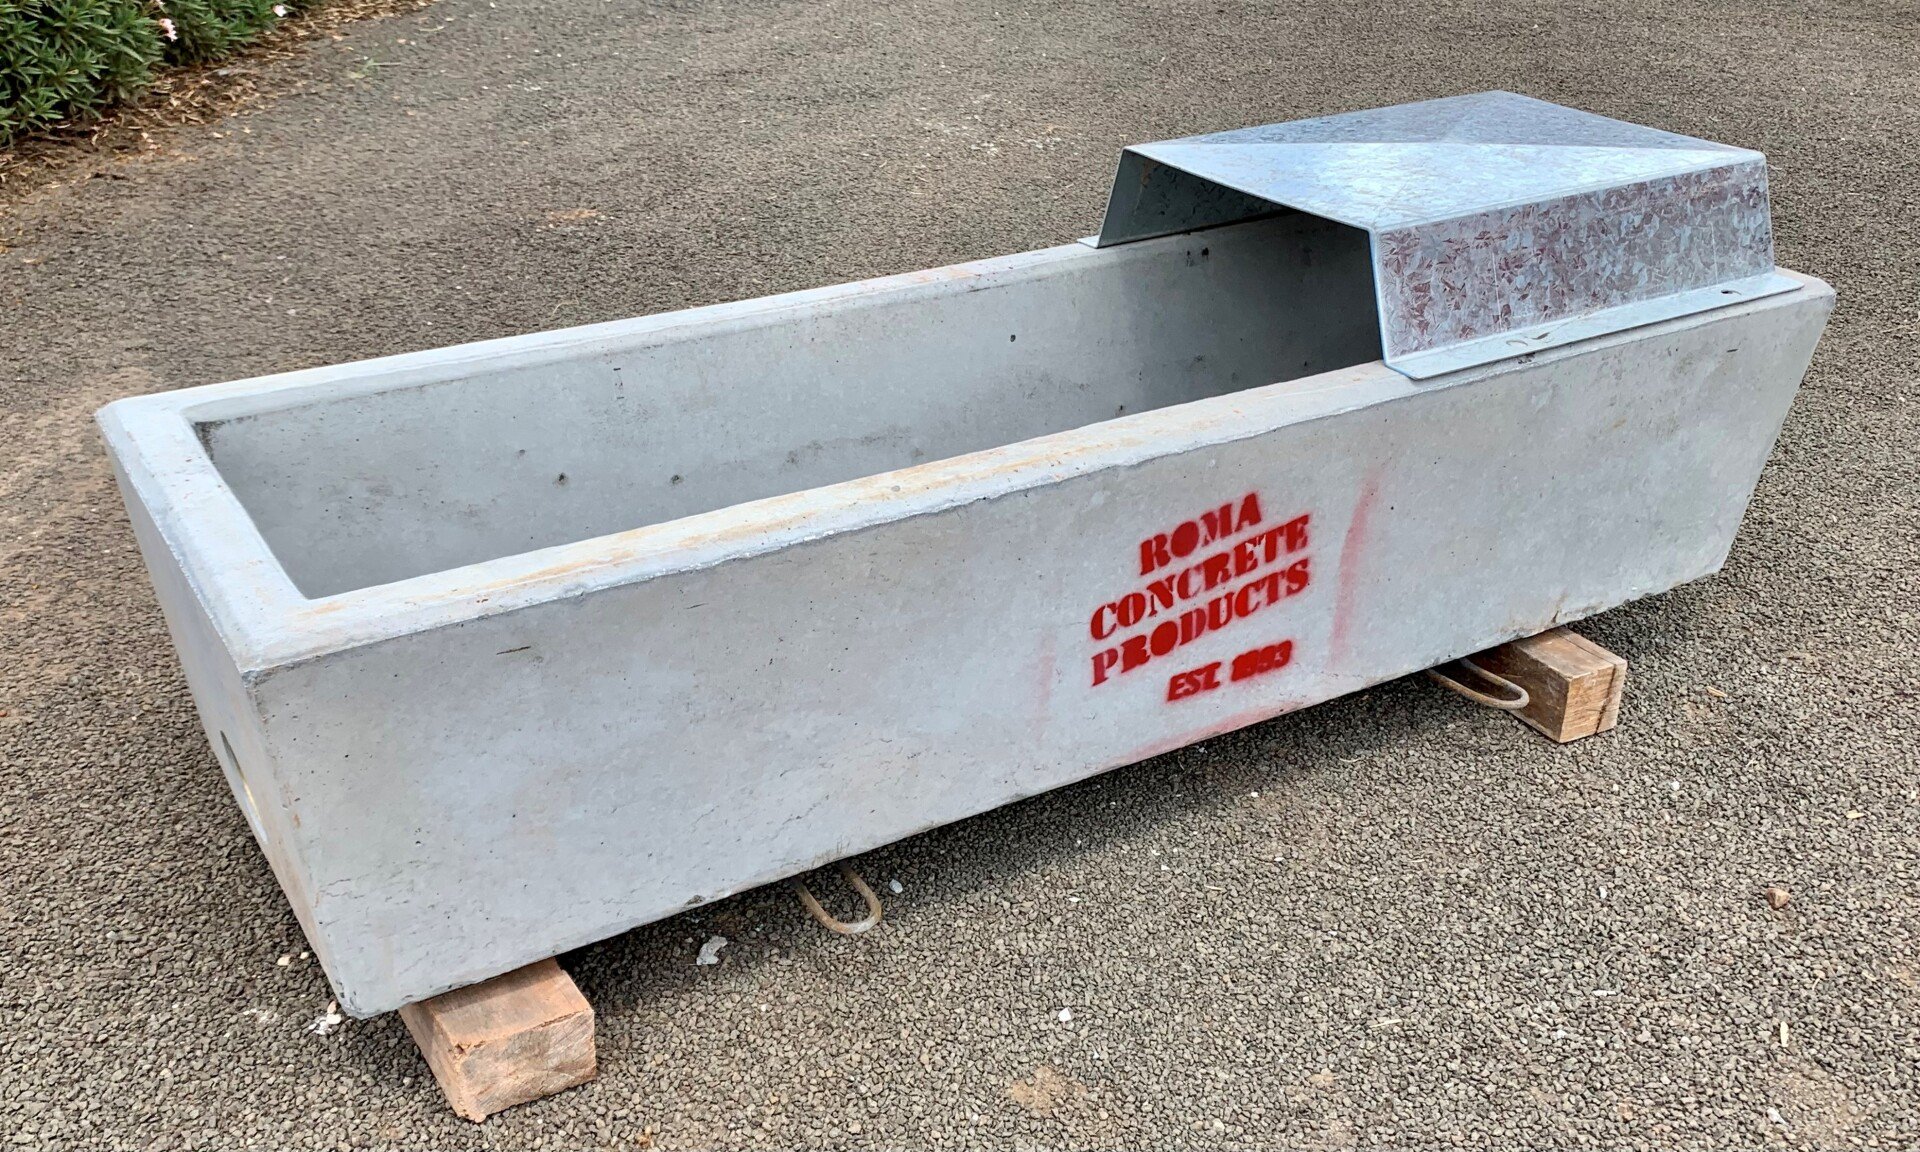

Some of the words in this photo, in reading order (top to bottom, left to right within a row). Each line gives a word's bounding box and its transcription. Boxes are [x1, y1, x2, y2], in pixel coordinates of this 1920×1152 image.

[1090, 514, 1310, 641] CONCRETE
[1139, 492, 1262, 576] ROMA
[1090, 557, 1309, 687] PRODUCTS
